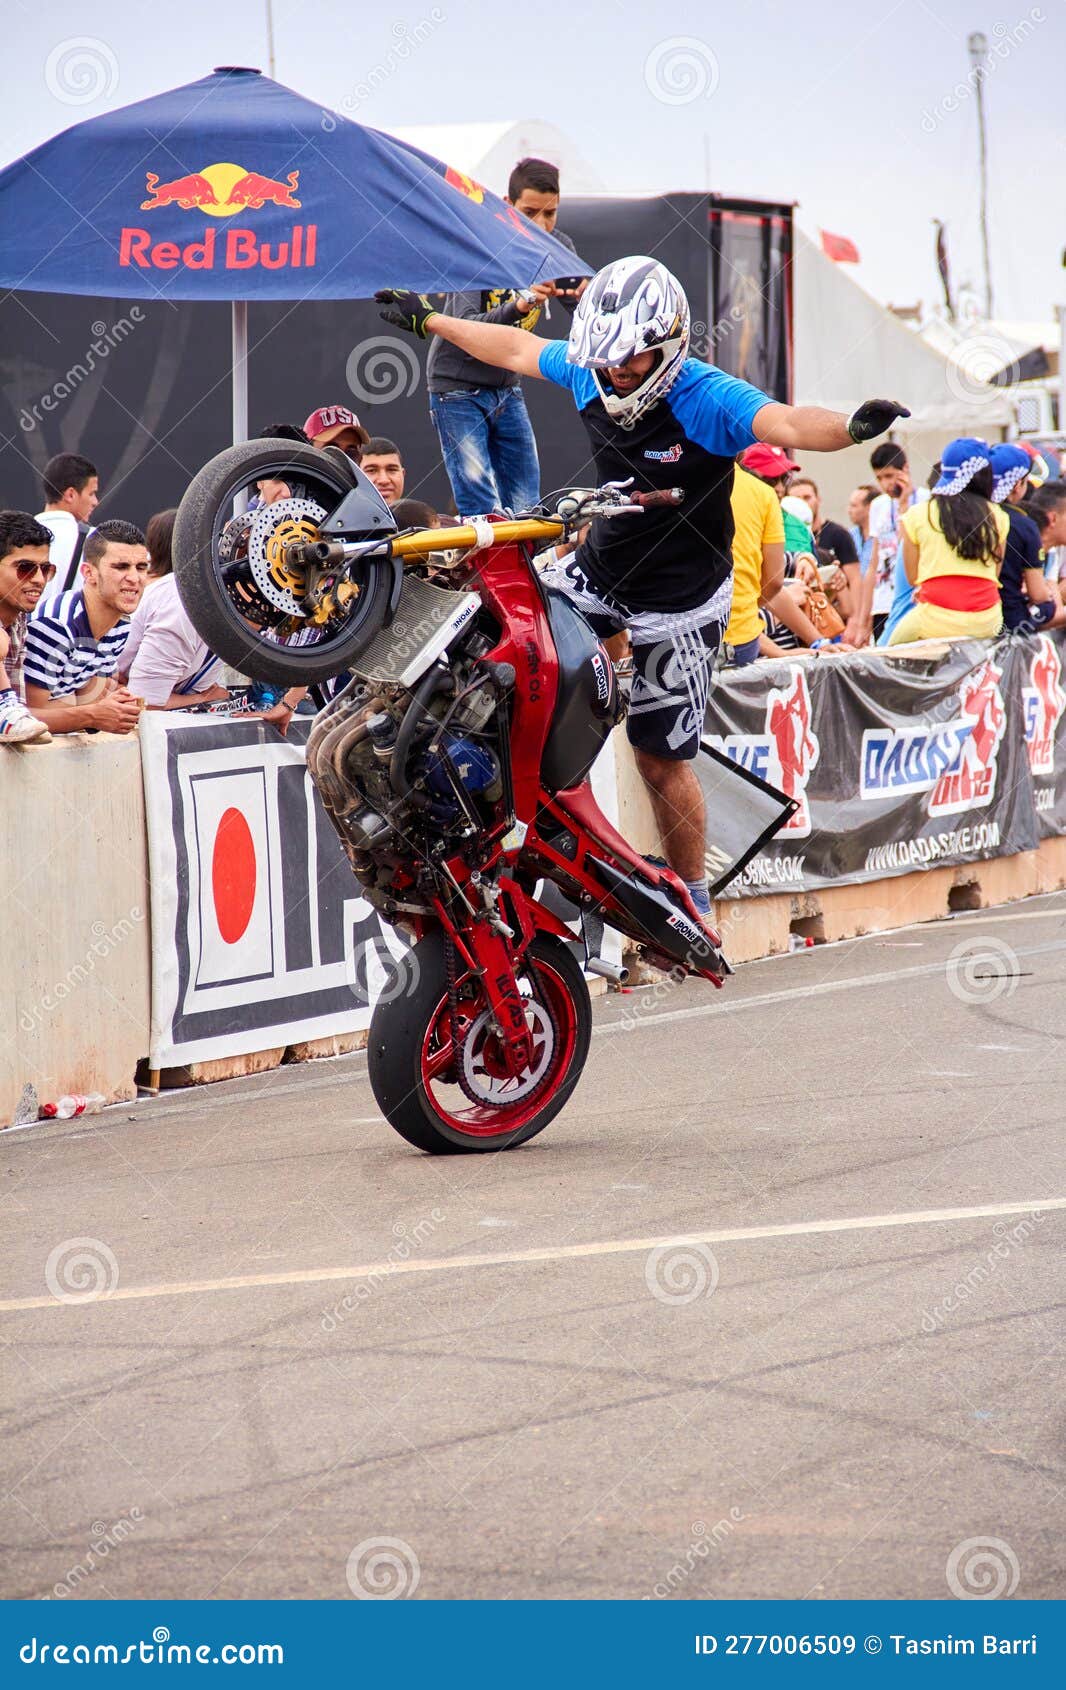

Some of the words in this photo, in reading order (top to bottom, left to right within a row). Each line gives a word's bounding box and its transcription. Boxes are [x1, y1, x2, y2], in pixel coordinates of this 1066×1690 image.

[118, 226, 217, 271] Red
[225, 224, 318, 270] Bull
[454, 607, 472, 629] IPONE
[595, 664, 608, 700] IPONE
[673, 918, 698, 942] IPONE
